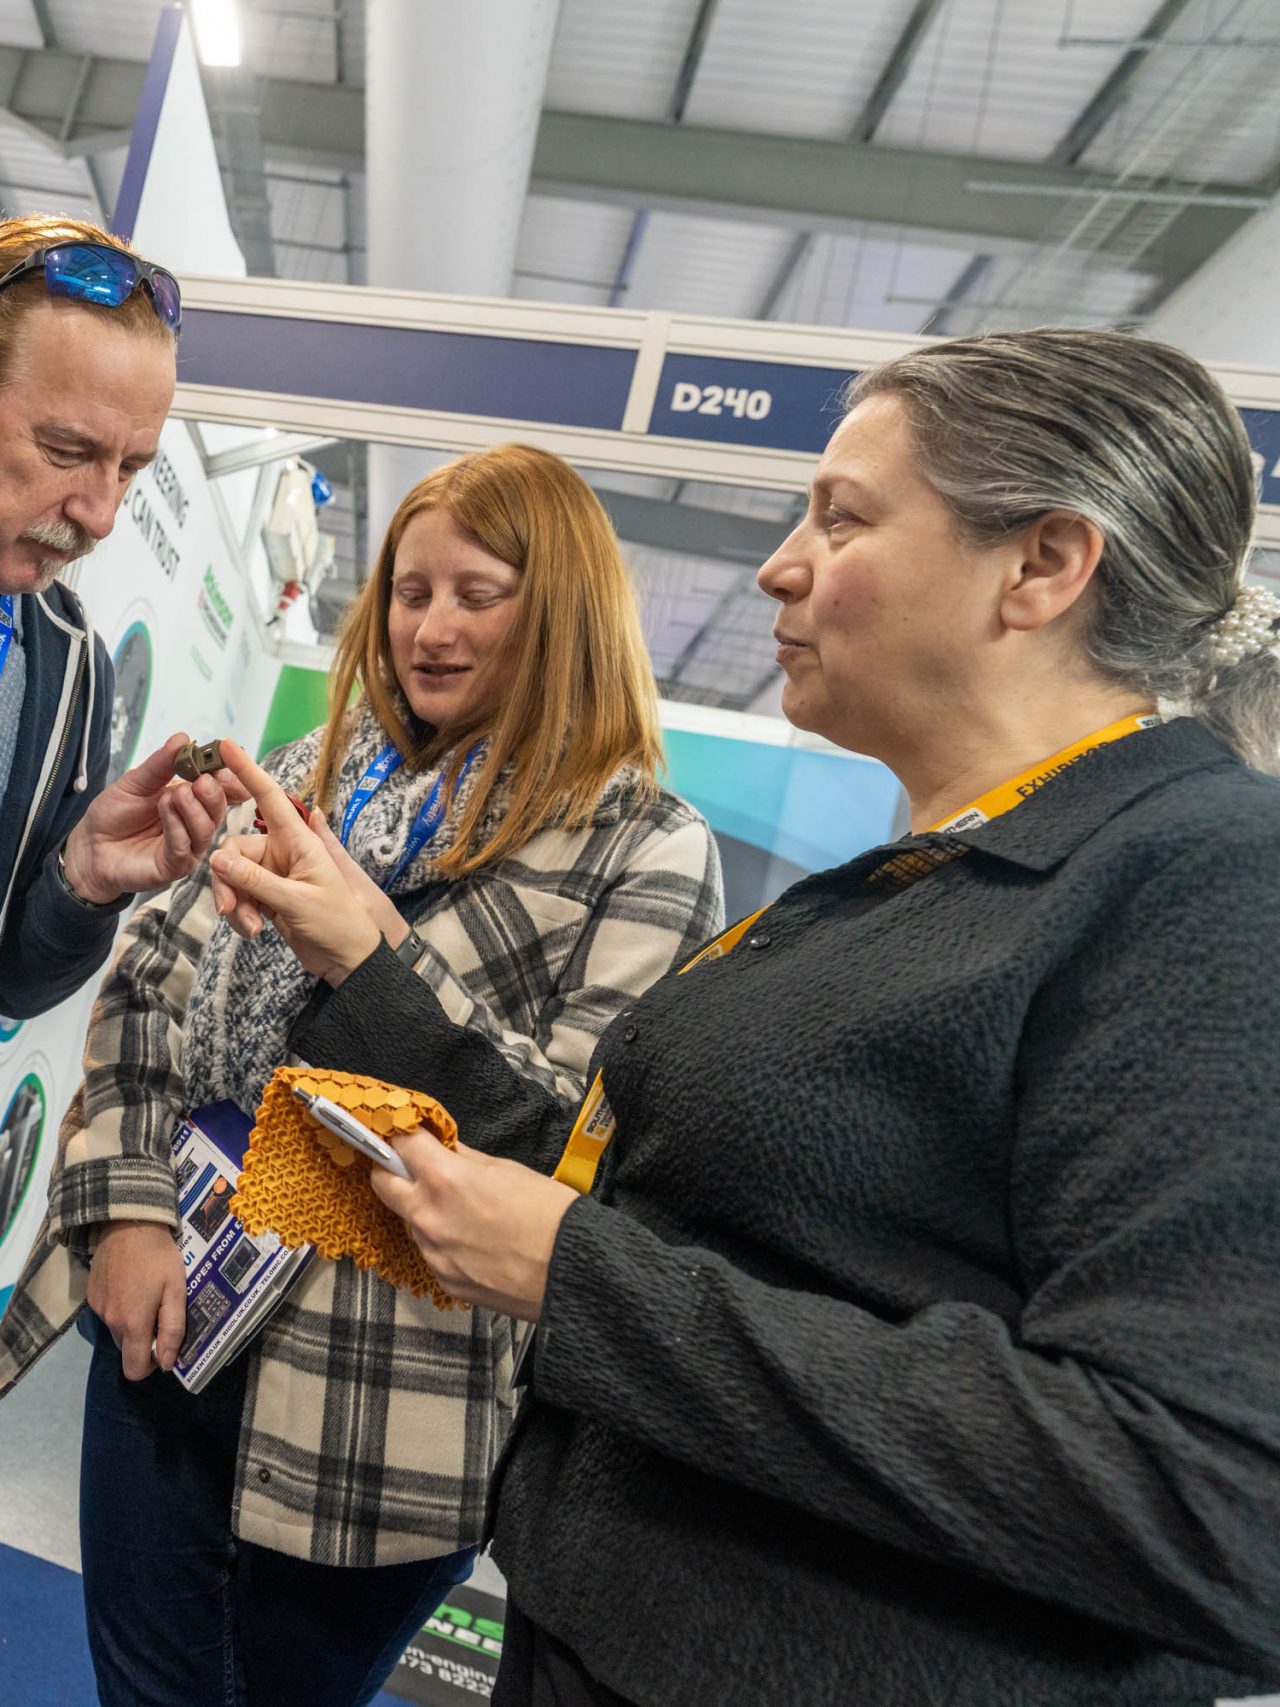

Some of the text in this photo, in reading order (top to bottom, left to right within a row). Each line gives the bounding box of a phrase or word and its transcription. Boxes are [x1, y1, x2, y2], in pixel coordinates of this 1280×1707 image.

[671, 382, 772, 420] D240
[132, 489, 180, 582] CAN TRUST
[374, 747, 399, 773] Xome
[179, 1234, 193, 1252] lies
[211, 1229, 235, 1261] FROM
[187, 1339, 222, 1384] SIGLENT.CO.UK
[222, 1288, 260, 1338] RIGOL-UK.CO.UK
